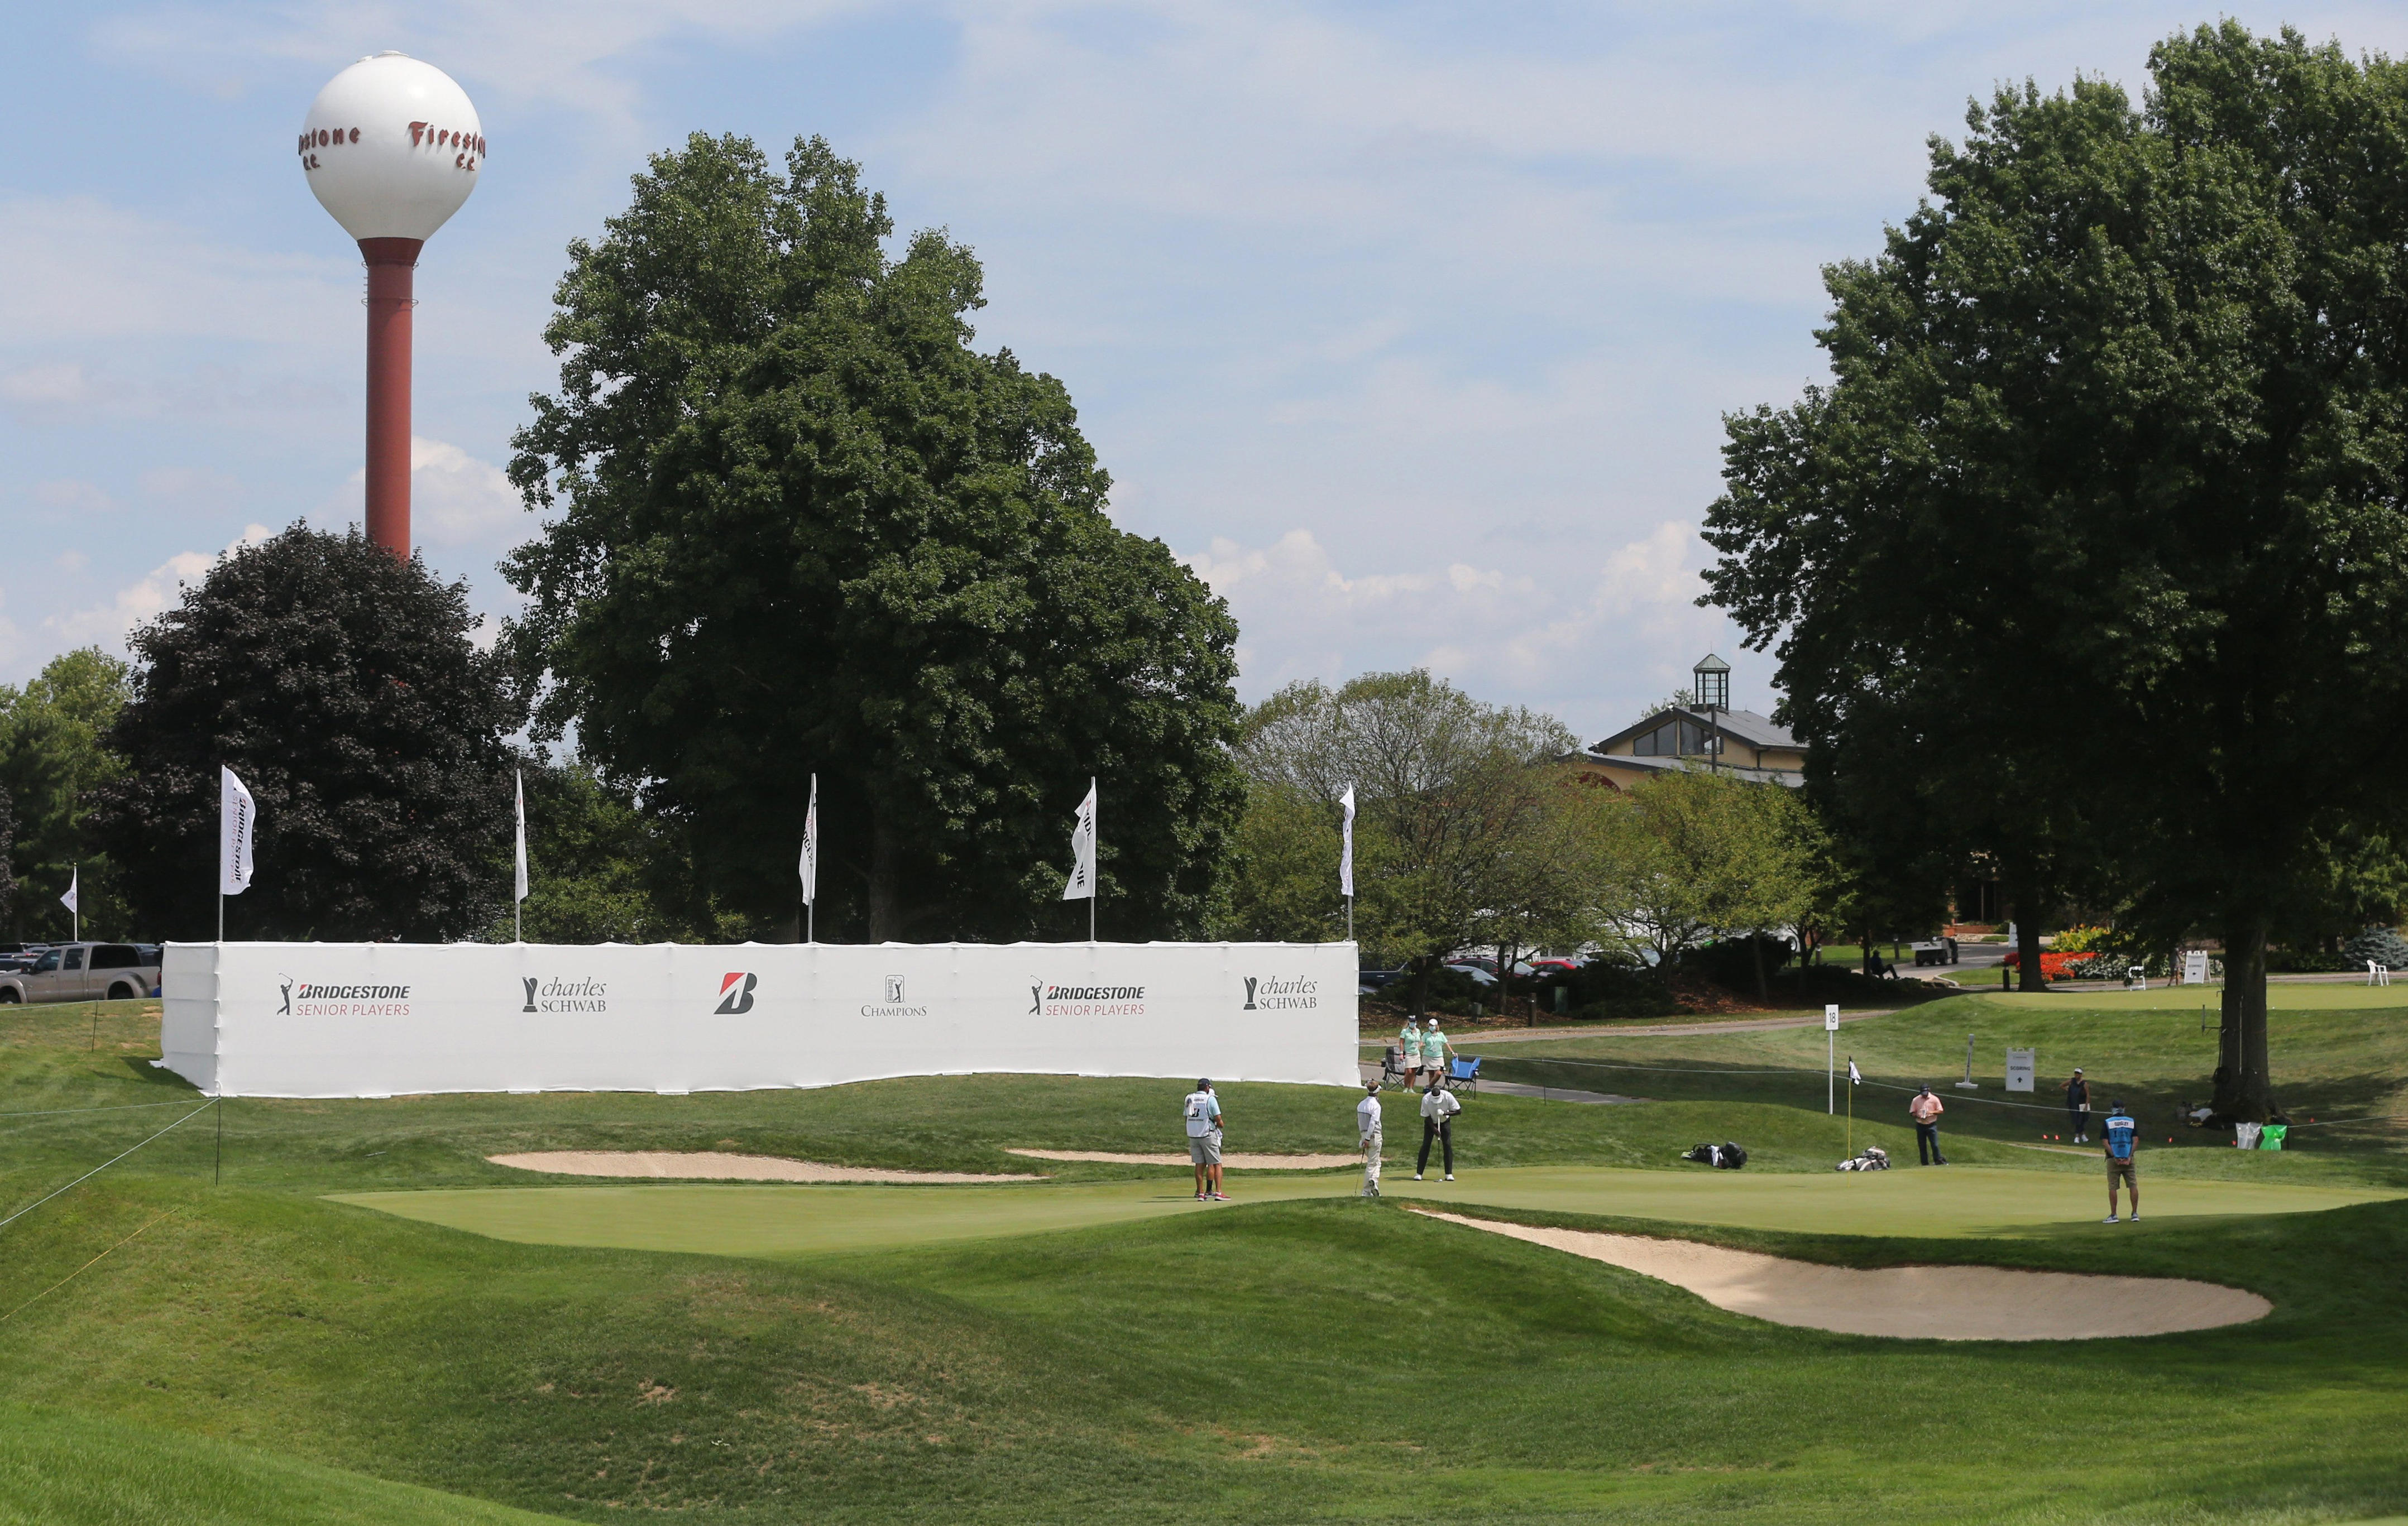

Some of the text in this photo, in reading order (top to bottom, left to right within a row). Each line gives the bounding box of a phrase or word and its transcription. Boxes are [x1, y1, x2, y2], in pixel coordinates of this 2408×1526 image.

[408, 121, 486, 159] Firesto
[297, 984, 410, 999] BRIDGESTONE
[542, 976, 606, 996] charles
[1260, 975, 1318, 995] charles
[1046, 986, 1145, 1000] BRIDGESTONE
[296, 1004, 410, 1015] SENIOR PLAYERS
[541, 1000, 606, 1012] SCHWAB
[1260, 997, 1317, 1009] SCHWAB
[1046, 1004, 1144, 1016] SENIOR PLAYERS
[1828, 1012, 1836, 1023] 18
